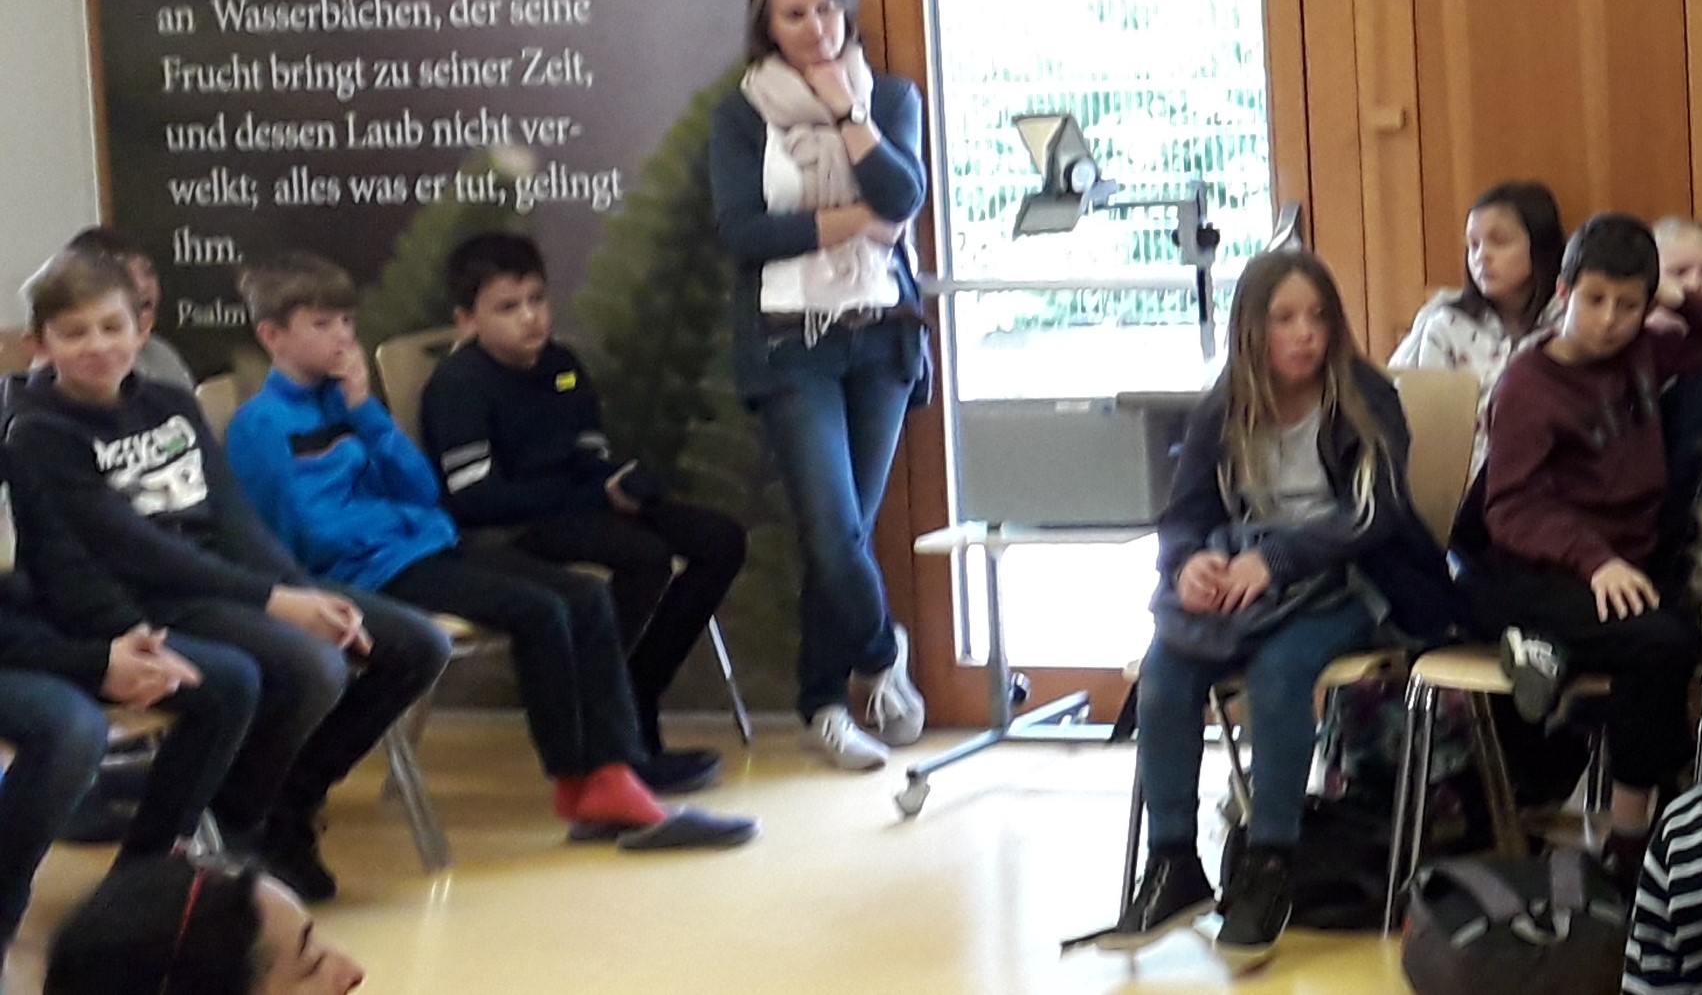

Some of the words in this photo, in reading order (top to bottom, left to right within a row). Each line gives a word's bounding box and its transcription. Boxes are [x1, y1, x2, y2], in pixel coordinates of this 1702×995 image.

[157, 4, 196, 34] an
[161, 53, 262, 93] Frucht
[270, 51, 364, 102] bringt
[373, 57, 411, 88] zu
[419, 51, 513, 87] seiner
[520, 48, 594, 89] Zeit,
[166, 112, 227, 152] und
[235, 111, 334, 149] dessen
[346, 110, 423, 149] Laub
[432, 108, 510, 147] nicht
[520, 116, 583, 145] ver-
[168, 167, 259, 209] welkt;
[273, 167, 341, 206] alles
[348, 173, 408, 205] was
[414, 173, 447, 203] er
[454, 170, 507, 205] tut,
[514, 165, 622, 213] gelingt
[173, 227, 243, 264] ihm.
